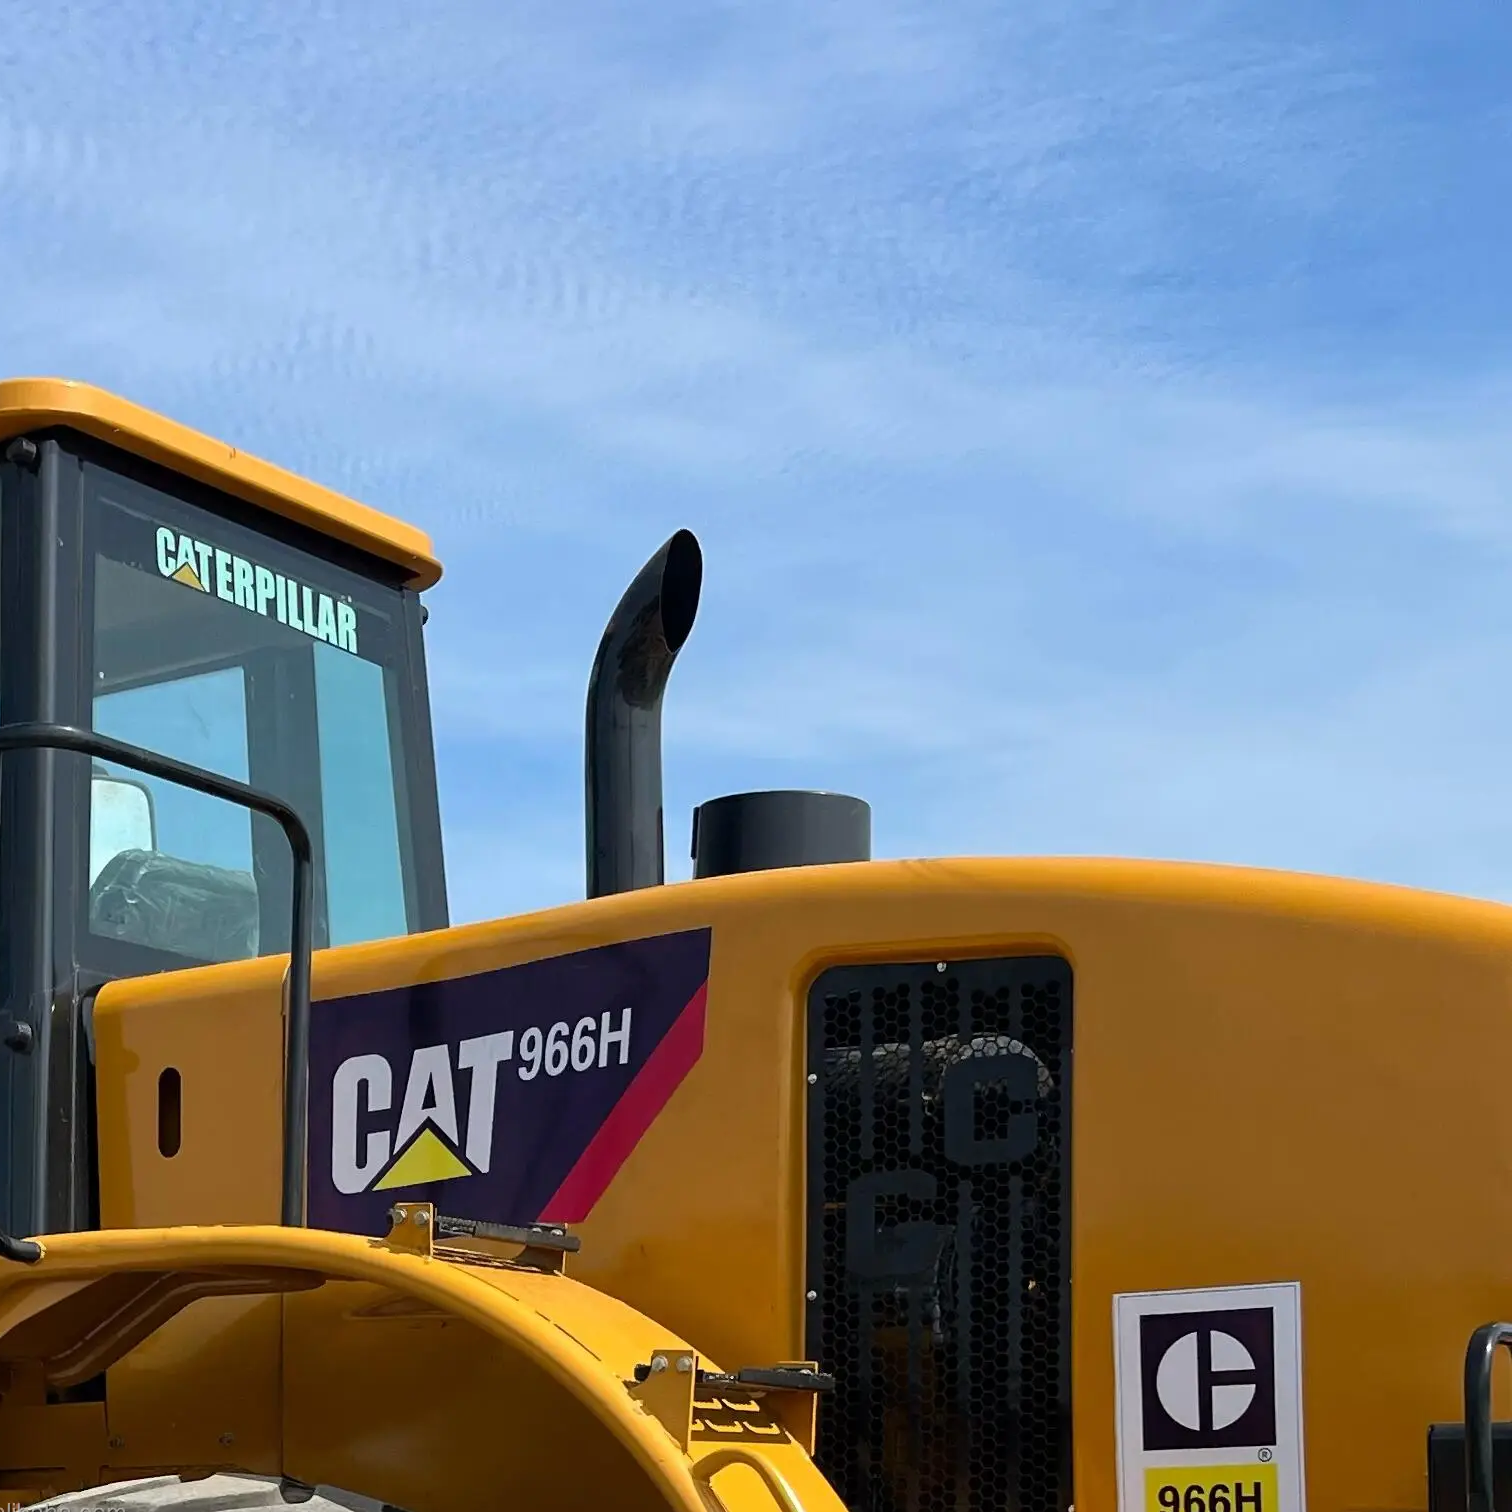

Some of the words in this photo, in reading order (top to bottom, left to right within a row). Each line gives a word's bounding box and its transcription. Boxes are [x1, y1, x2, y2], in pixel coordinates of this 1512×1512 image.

[155, 526, 358, 654] CATERPILLAR
[331, 1030, 514, 1194] CAT
[518, 1007, 632, 1081] 966H
